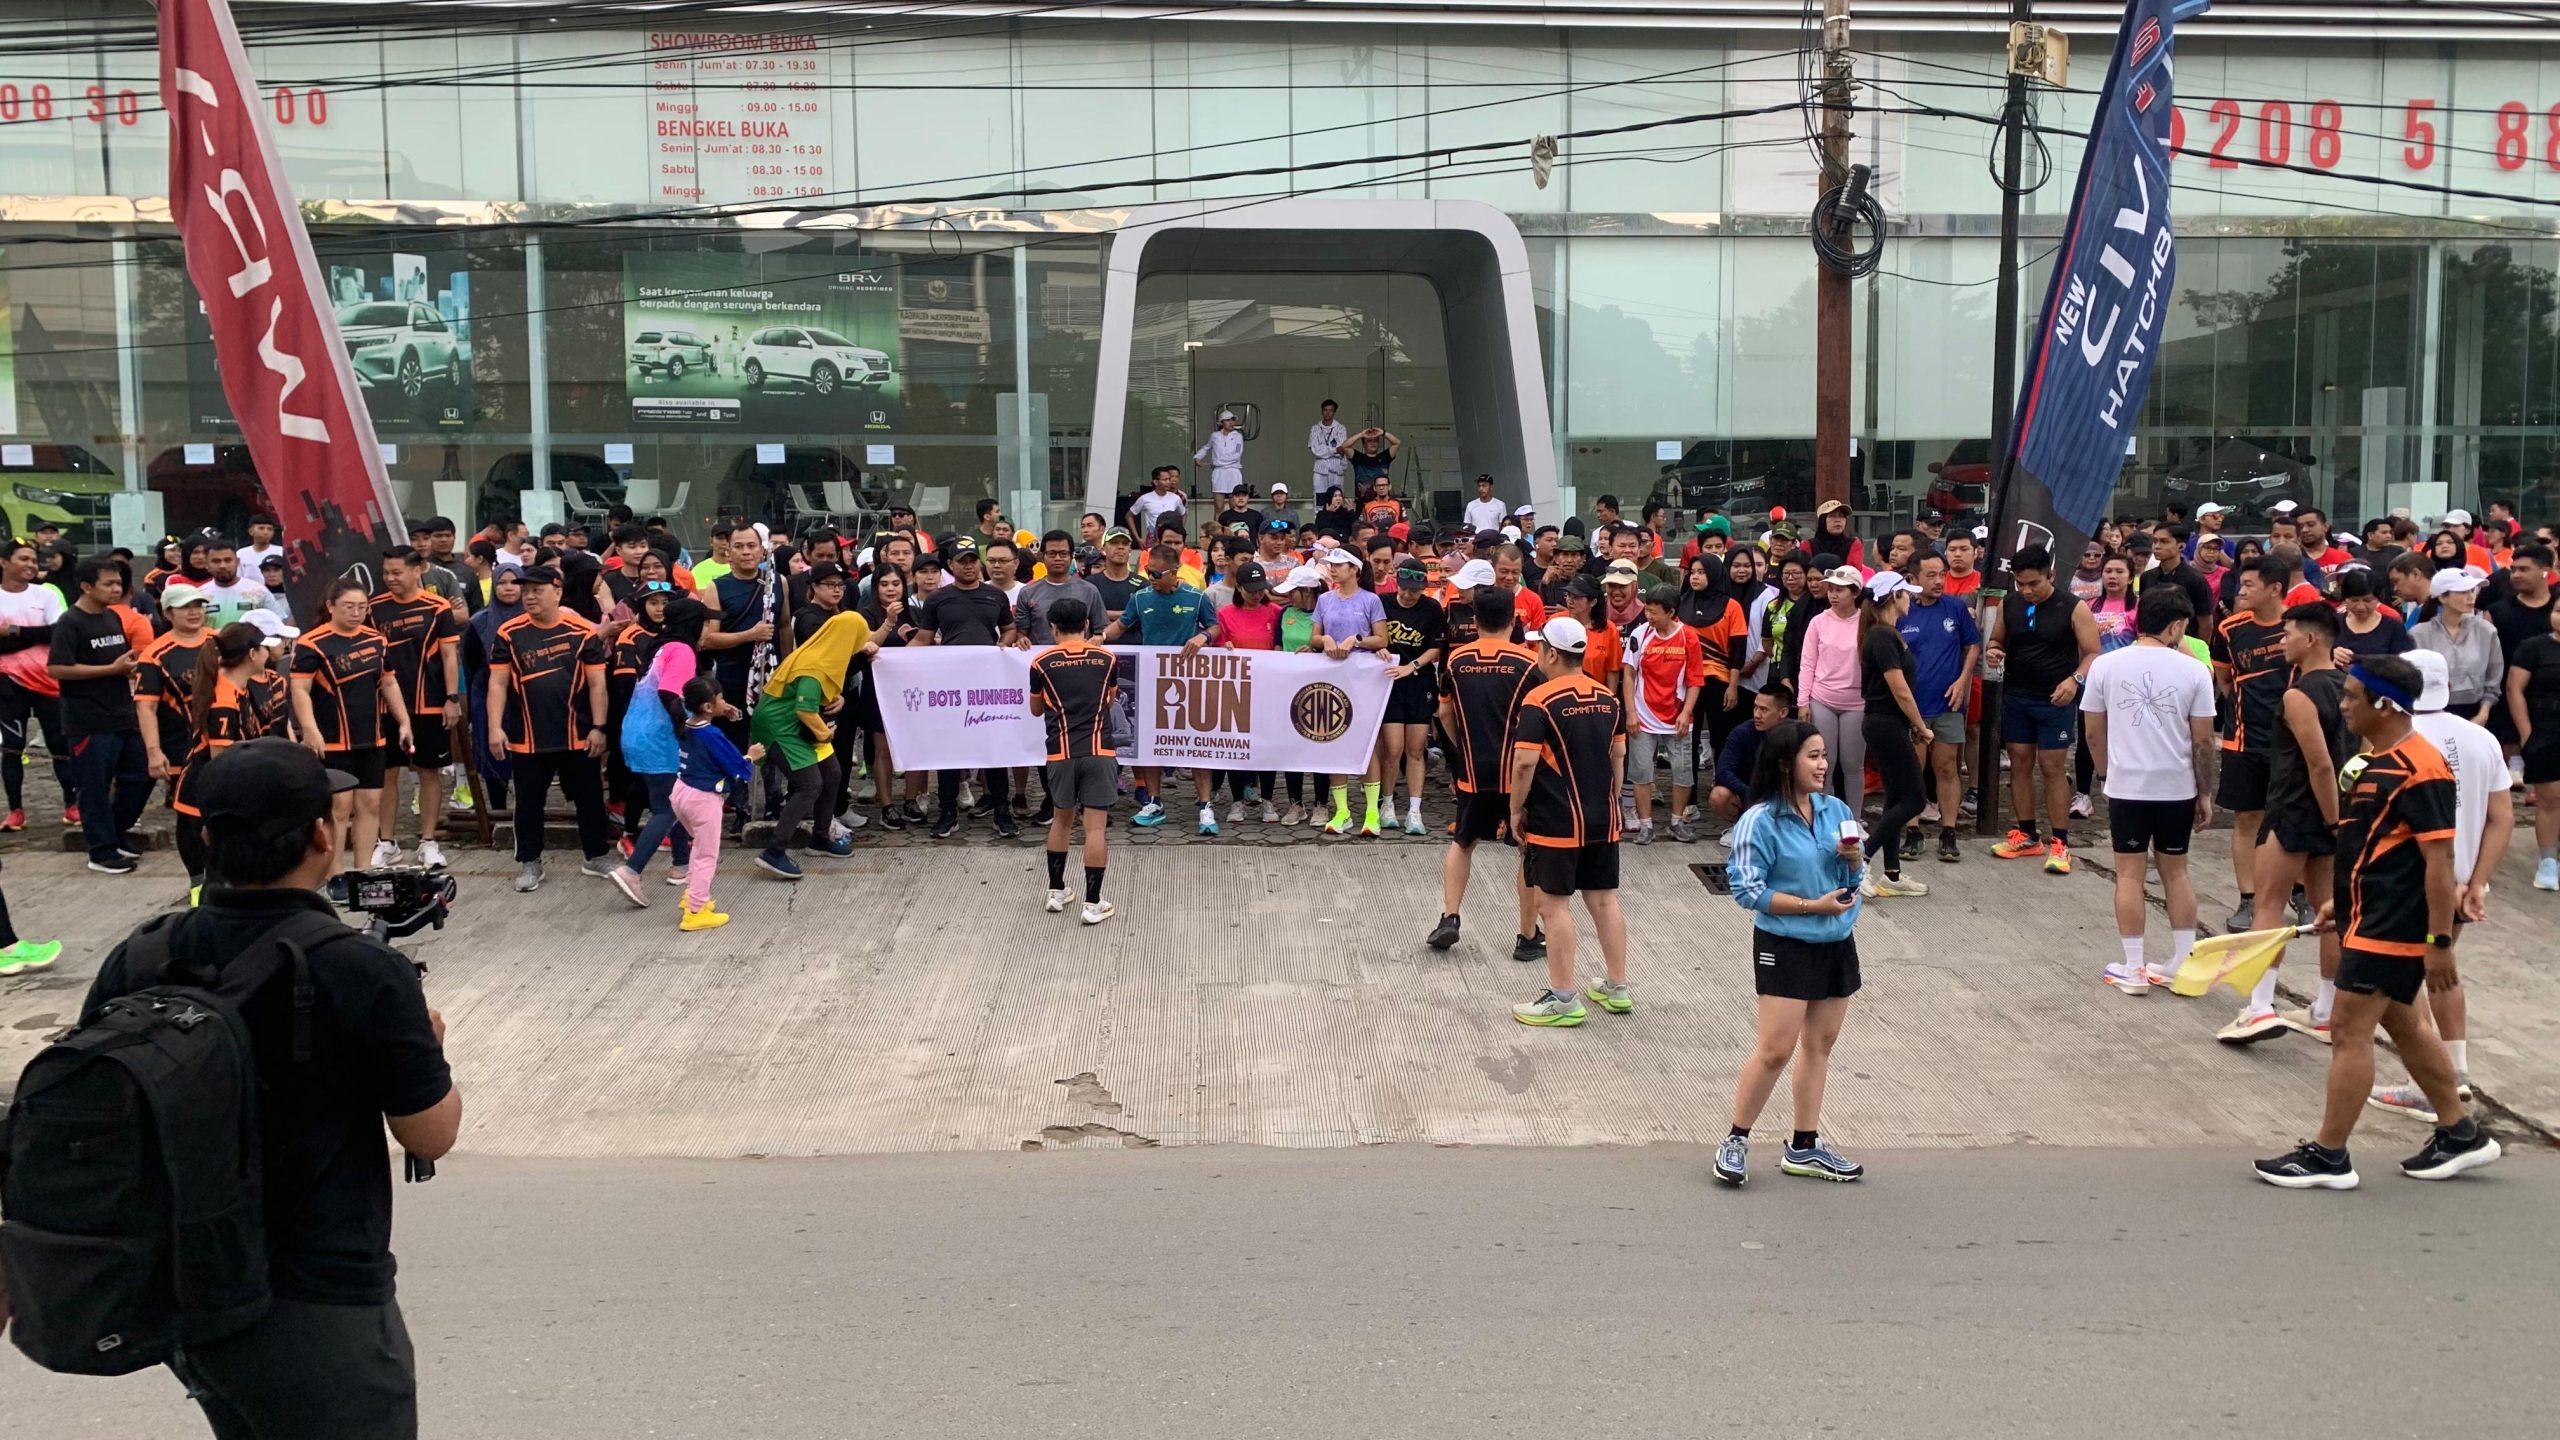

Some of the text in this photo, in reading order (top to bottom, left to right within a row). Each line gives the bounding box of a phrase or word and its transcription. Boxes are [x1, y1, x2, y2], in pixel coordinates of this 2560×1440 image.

[651, 33, 818, 51] SHOWROOM BUKA
[654, 60, 816, 70] Senin Jum'at 07.30 19.30
[656, 102, 817, 114] Minggu 09.00 15.00
[657, 120, 789, 138] BENGKEL BUKA
[660, 143, 693, 153] Senin
[704, 143, 743, 154] Jum'at
[752, 144, 782, 154] 08.30
[661, 164, 695, 174] Sabtu
[752, 165, 782, 175] 08.30
[663, 186, 824, 198] Minggu 08.30 15.00
[838, 274, 882, 283] BR-V
[639, 287, 774, 300] Saat kenyamanan keluarga
[640, 299, 822, 312] berpadu dengan serunya berkendara
[2055, 273, 2086, 346] NEW
[2100, 225, 2173, 429] HATCHB
[1050, 657, 1105, 668] COMMITTEE
[1156, 653, 1252, 680] TRIBUTE
[1459, 665, 1515, 674] COMMITTEE
[928, 688, 1024, 707] BOTS RUNNERS
[1155, 678, 1252, 733] RUN
[1562, 704, 1612, 717] COMMITTEE
[964, 709, 1022, 728] Indonesia
[1154, 735, 1250, 750] JOHNY GUNAWAN
[1154, 748, 1251, 760] REST IN PEACE 17.11.24
